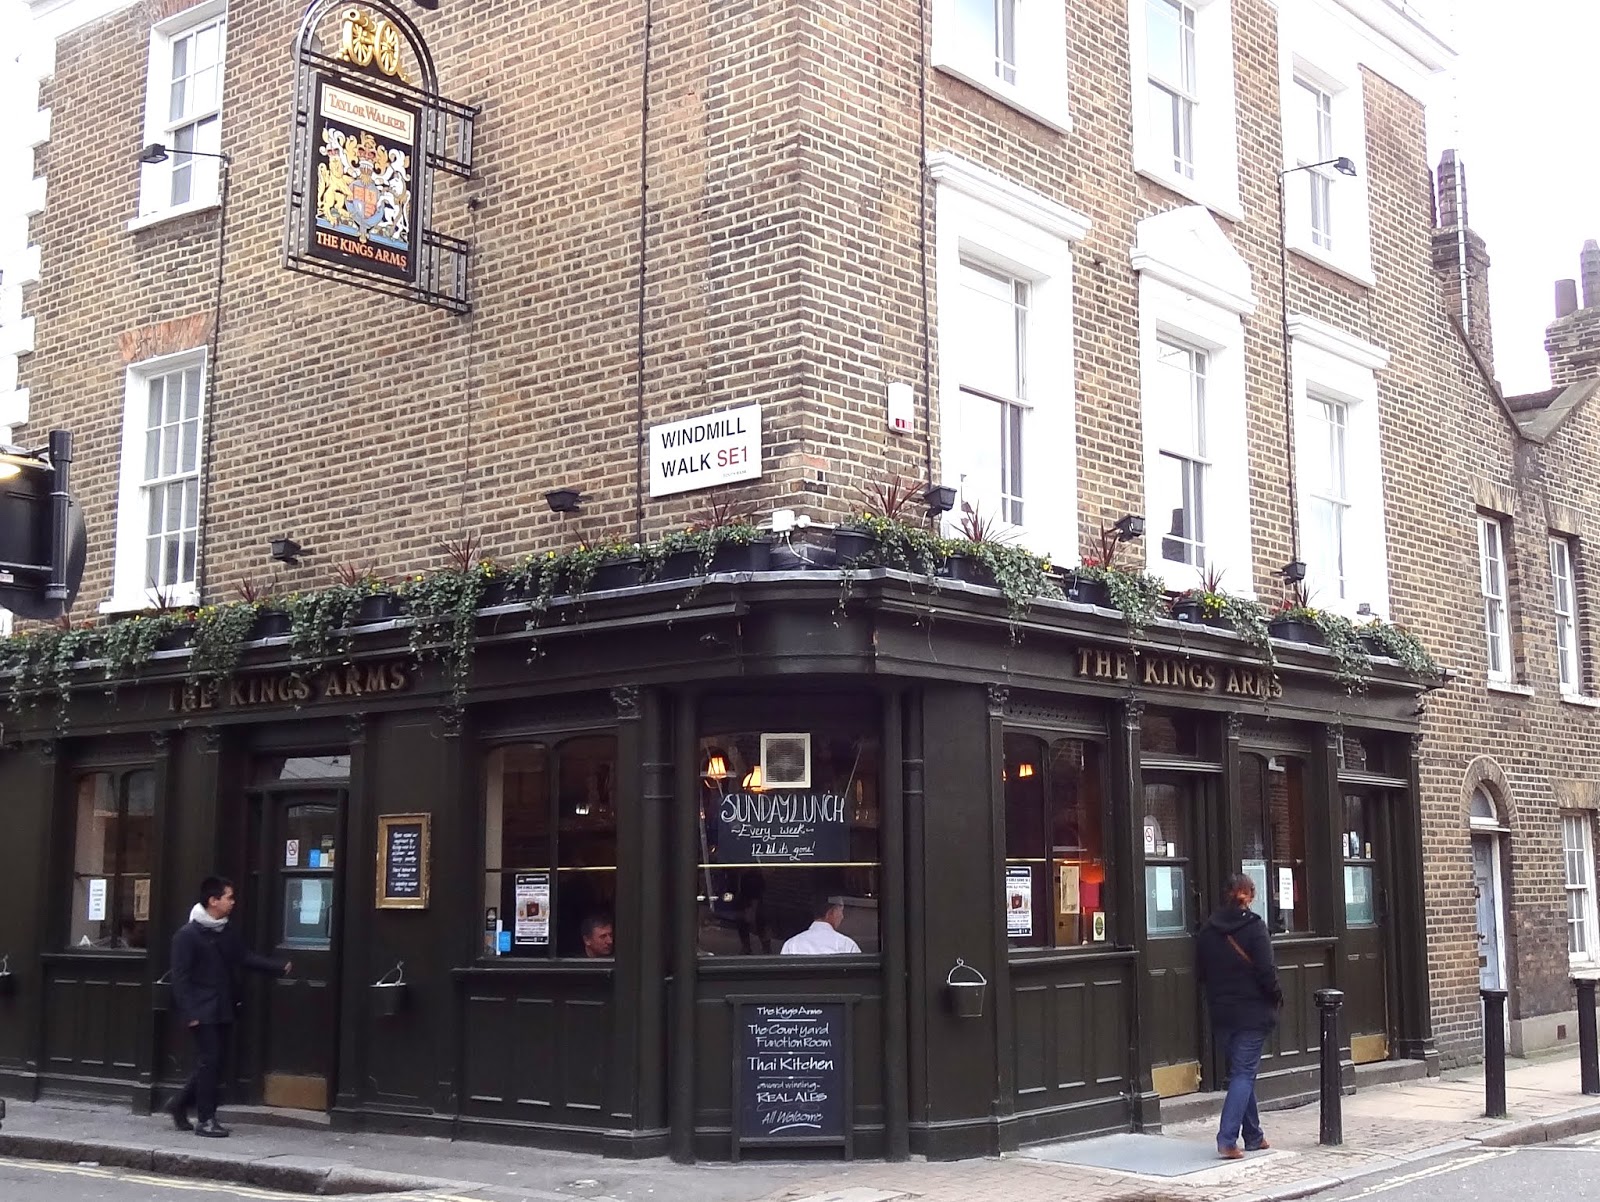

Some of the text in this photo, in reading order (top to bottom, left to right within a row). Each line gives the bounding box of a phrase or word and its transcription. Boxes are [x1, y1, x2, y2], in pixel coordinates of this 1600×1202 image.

[329, 93, 407, 132] TAYLOR WALKER
[316, 231, 408, 268] THE KINGS ARMS
[661, 417, 747, 449] WINDMILL
[661, 445, 748, 478] WALK SE1
[229, 674, 310, 706] KINGS
[325, 663, 406, 697] ARMS
[1078, 647, 1283, 699] THE KINGS ARMS
[720, 793, 845, 824] SUNDAY LUNCH
[751, 843, 763, 855] 12
[757, 1006, 775, 1015] The
[798, 1005, 823, 1015] Arms
[747, 1024, 768, 1035] The
[756, 1036, 831, 1048] Function Room
[747, 1056, 834, 1071] Thai Kitchen
[756, 1091, 828, 1103] REAL ALES
[761, 1110, 823, 1125] All Welcome
